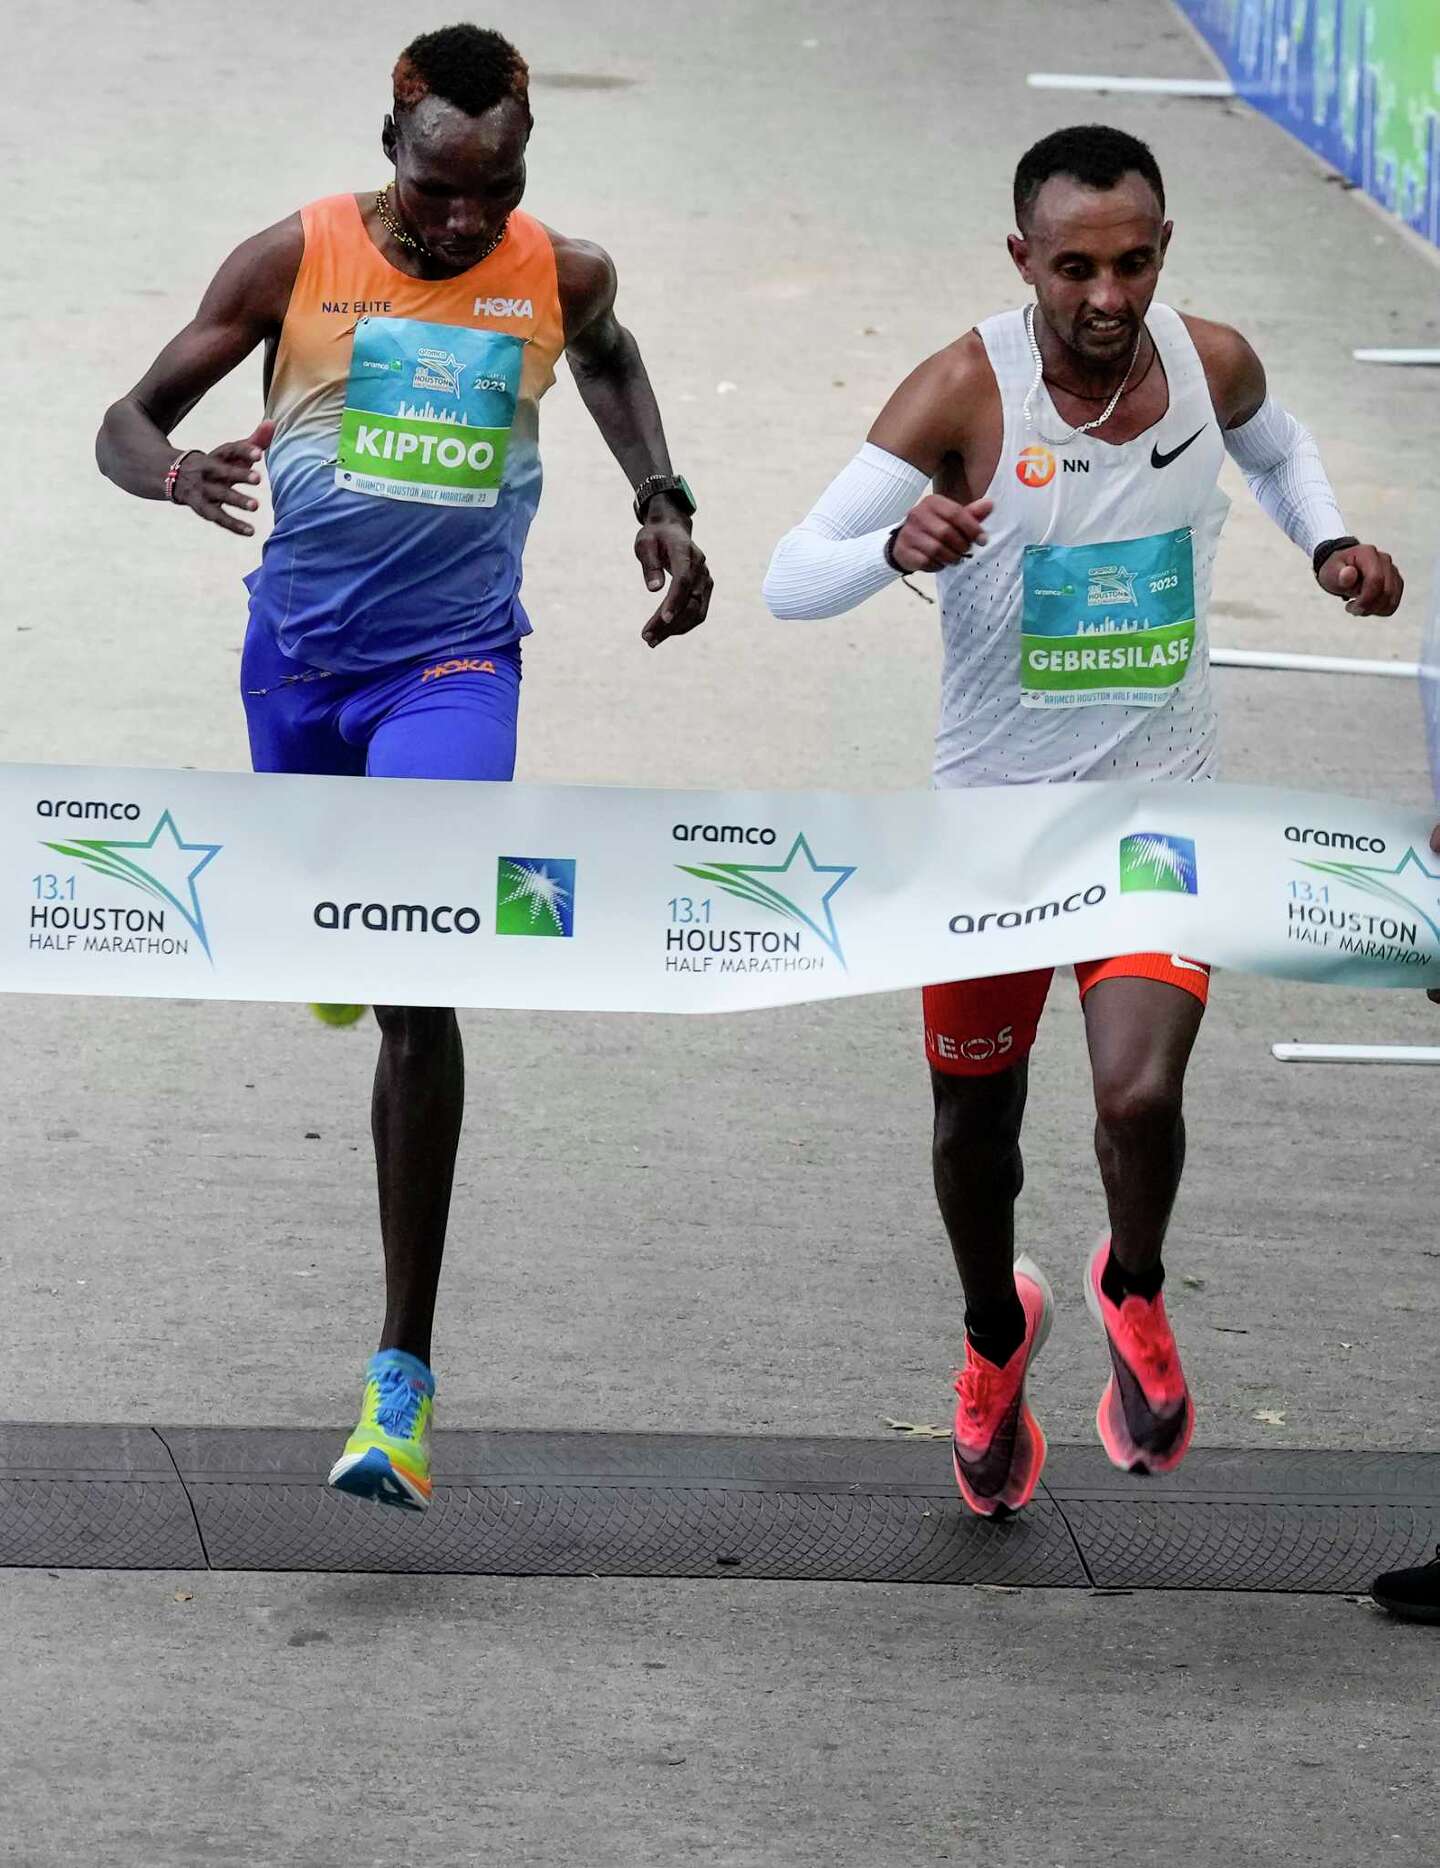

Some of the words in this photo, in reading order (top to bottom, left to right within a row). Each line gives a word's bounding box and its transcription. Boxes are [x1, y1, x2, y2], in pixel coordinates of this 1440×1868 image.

[322, 301, 348, 313] NAZ
[354, 301, 391, 313] ELITE
[473, 298, 533, 319] HOKA
[472, 378, 506, 392] 2023
[355, 425, 495, 471] KIPTOO
[1063, 459, 1090, 473] NN
[1149, 575, 1179, 593] 2023
[1028, 638, 1190, 672] GEBRESILASE
[422, 659, 496, 682] HOKA
[36, 799, 141, 821] aramco
[672, 823, 776, 846] aramco
[1284, 826, 1386, 854] aramco
[32, 874, 76, 901] 13.1
[1288, 879, 1329, 905] 13.1
[30, 906, 164, 933] HOUSTON
[313, 901, 481, 934] aramco
[667, 898, 711, 924] 13.1
[949, 884, 1107, 934] aramco
[1288, 903, 1417, 946] HOUSTON
[29, 933, 76, 951] HALF
[83, 935, 188, 956] MARATHON
[666, 929, 801, 953] HOUSTON
[1288, 925, 1330, 946] HALF
[1340, 936, 1432, 966] MARATHON
[665, 956, 712, 973] HALF
[720, 956, 824, 973] MARATHON
